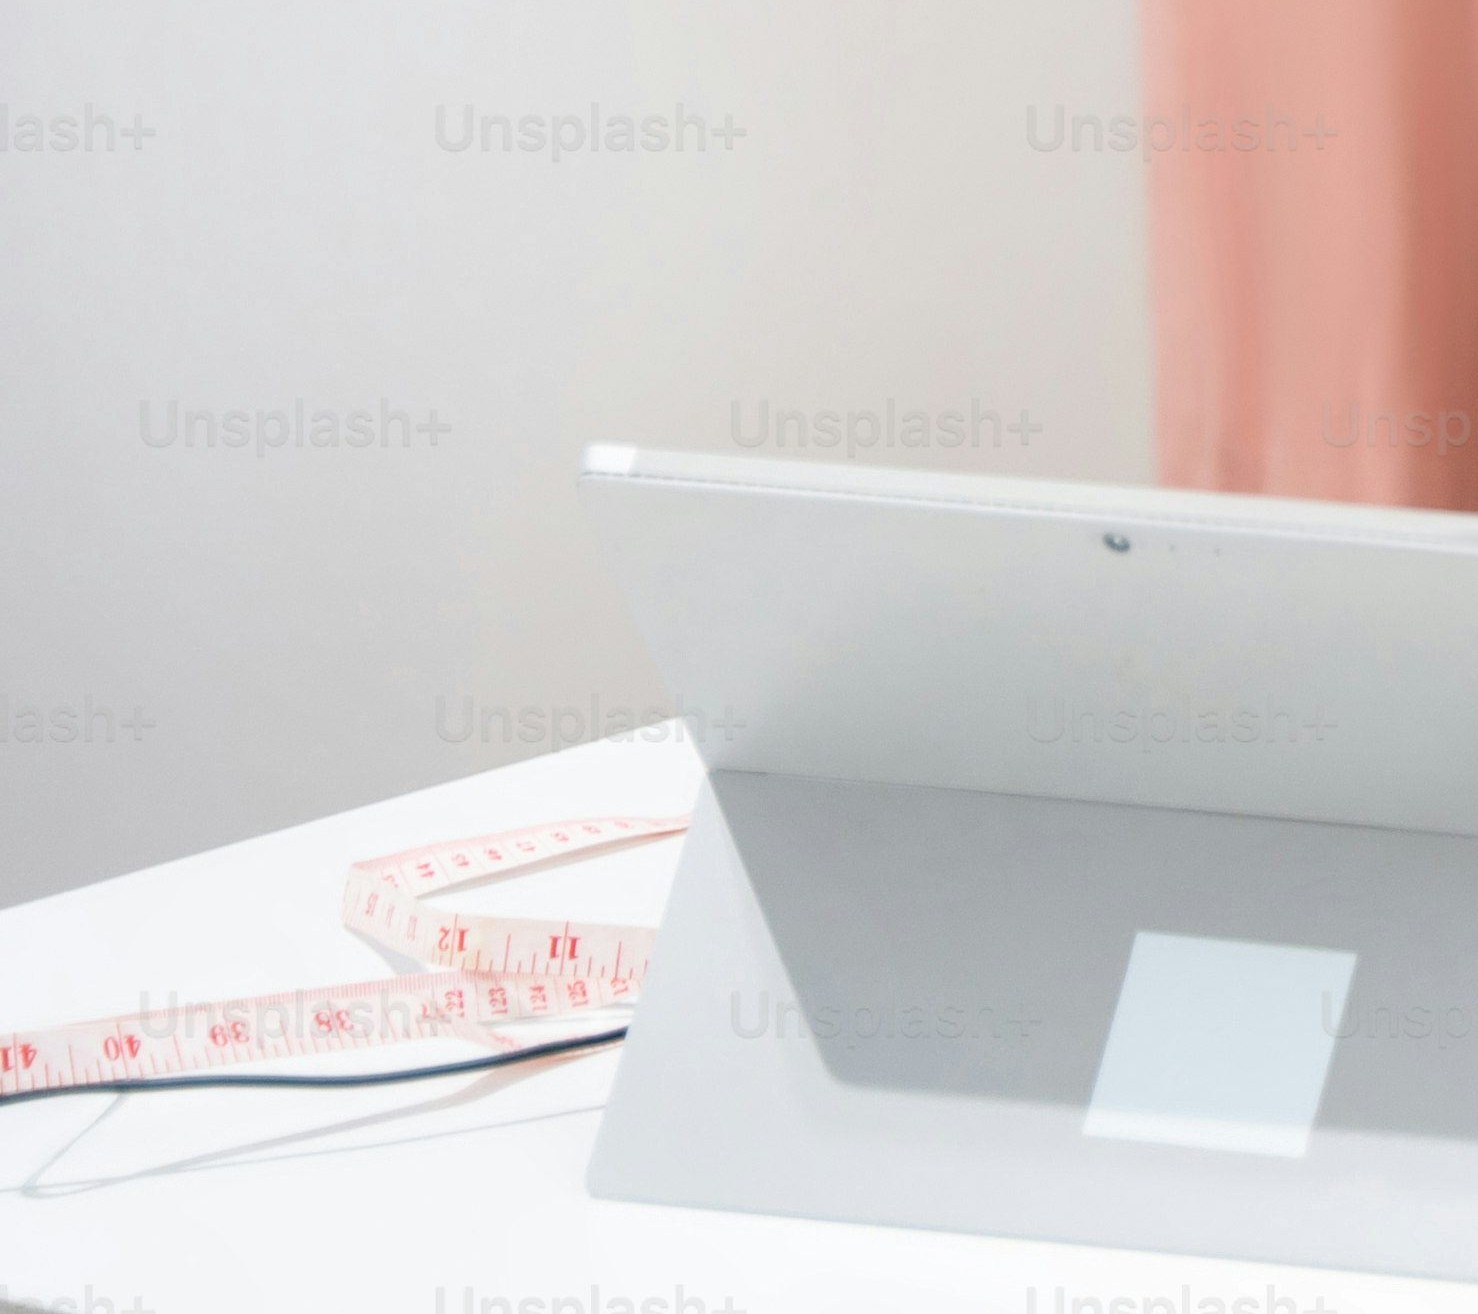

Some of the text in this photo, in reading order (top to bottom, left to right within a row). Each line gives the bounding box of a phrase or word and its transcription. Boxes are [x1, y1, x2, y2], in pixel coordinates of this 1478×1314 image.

[437, 926, 581, 961] 11 12
[488, 986, 509, 1015] 123
[529, 984, 550, 1013] 124
[566, 979, 589, 1009] 125
[208, 1020, 251, 1048] 39
[313, 1009, 356, 1035] 38
[103, 1033, 142, 1062] 40
